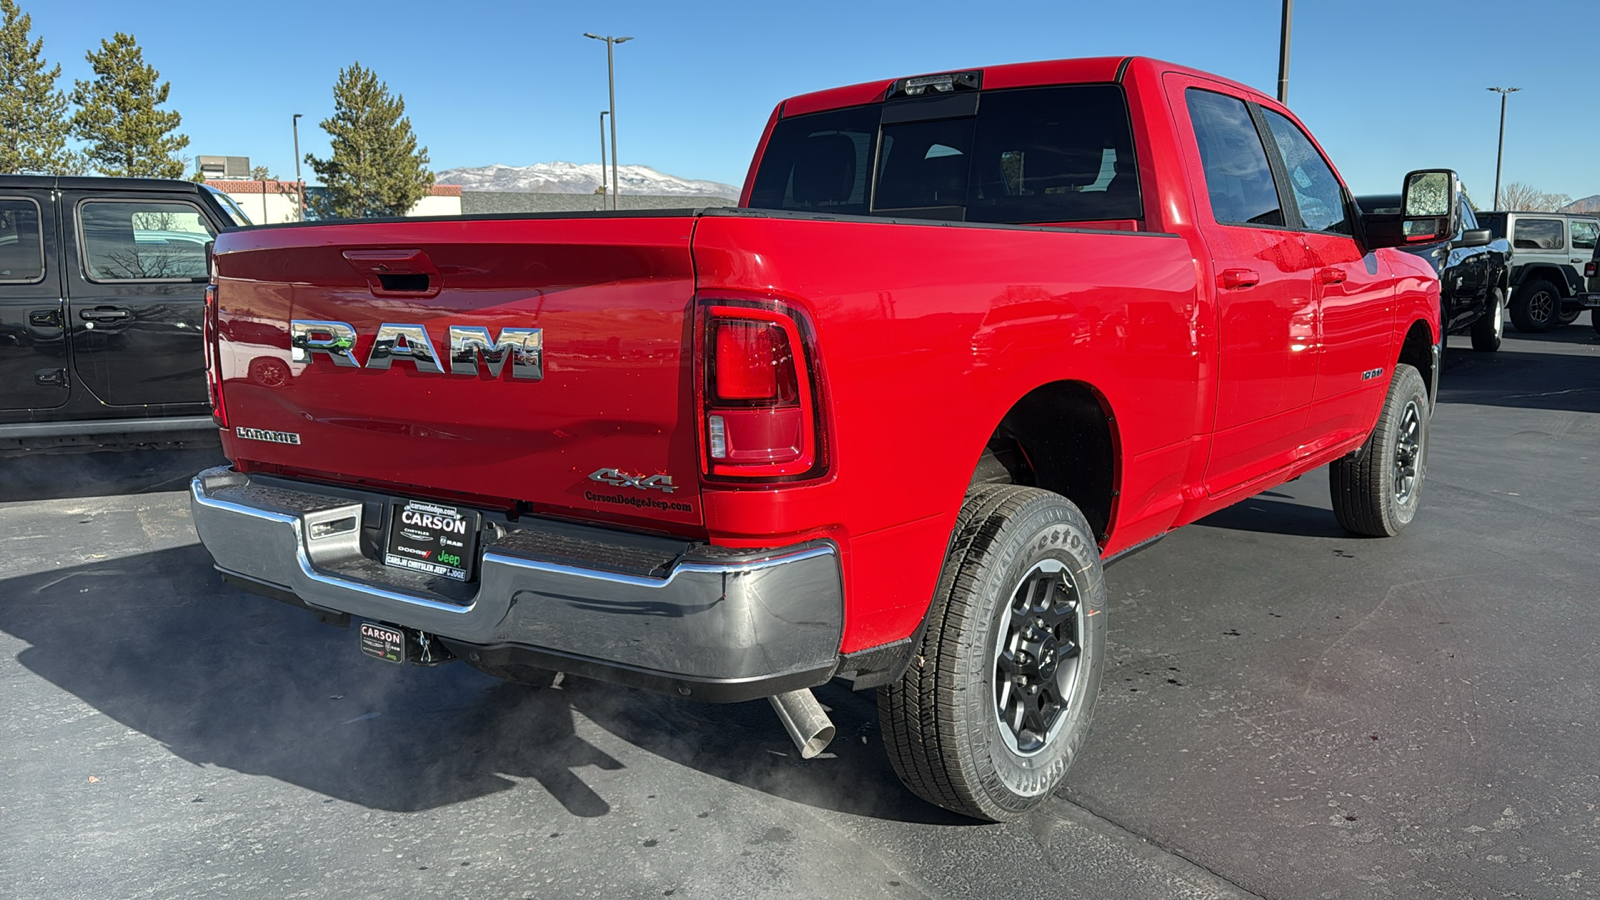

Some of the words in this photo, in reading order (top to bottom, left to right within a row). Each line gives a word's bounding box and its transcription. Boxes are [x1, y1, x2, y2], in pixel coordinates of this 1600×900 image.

[291, 319, 544, 380] RAM
[236, 426, 301, 445] LARAMIE
[411, 503, 455, 516] carsondodge.com
[585, 491, 692, 512] CarsonDodgeJeep.com
[402, 511, 466, 534] CARSON
[404, 528, 429, 536] CHRYSLER
[438, 550, 460, 566] Jeep
[362, 626, 400, 644] CARSON
